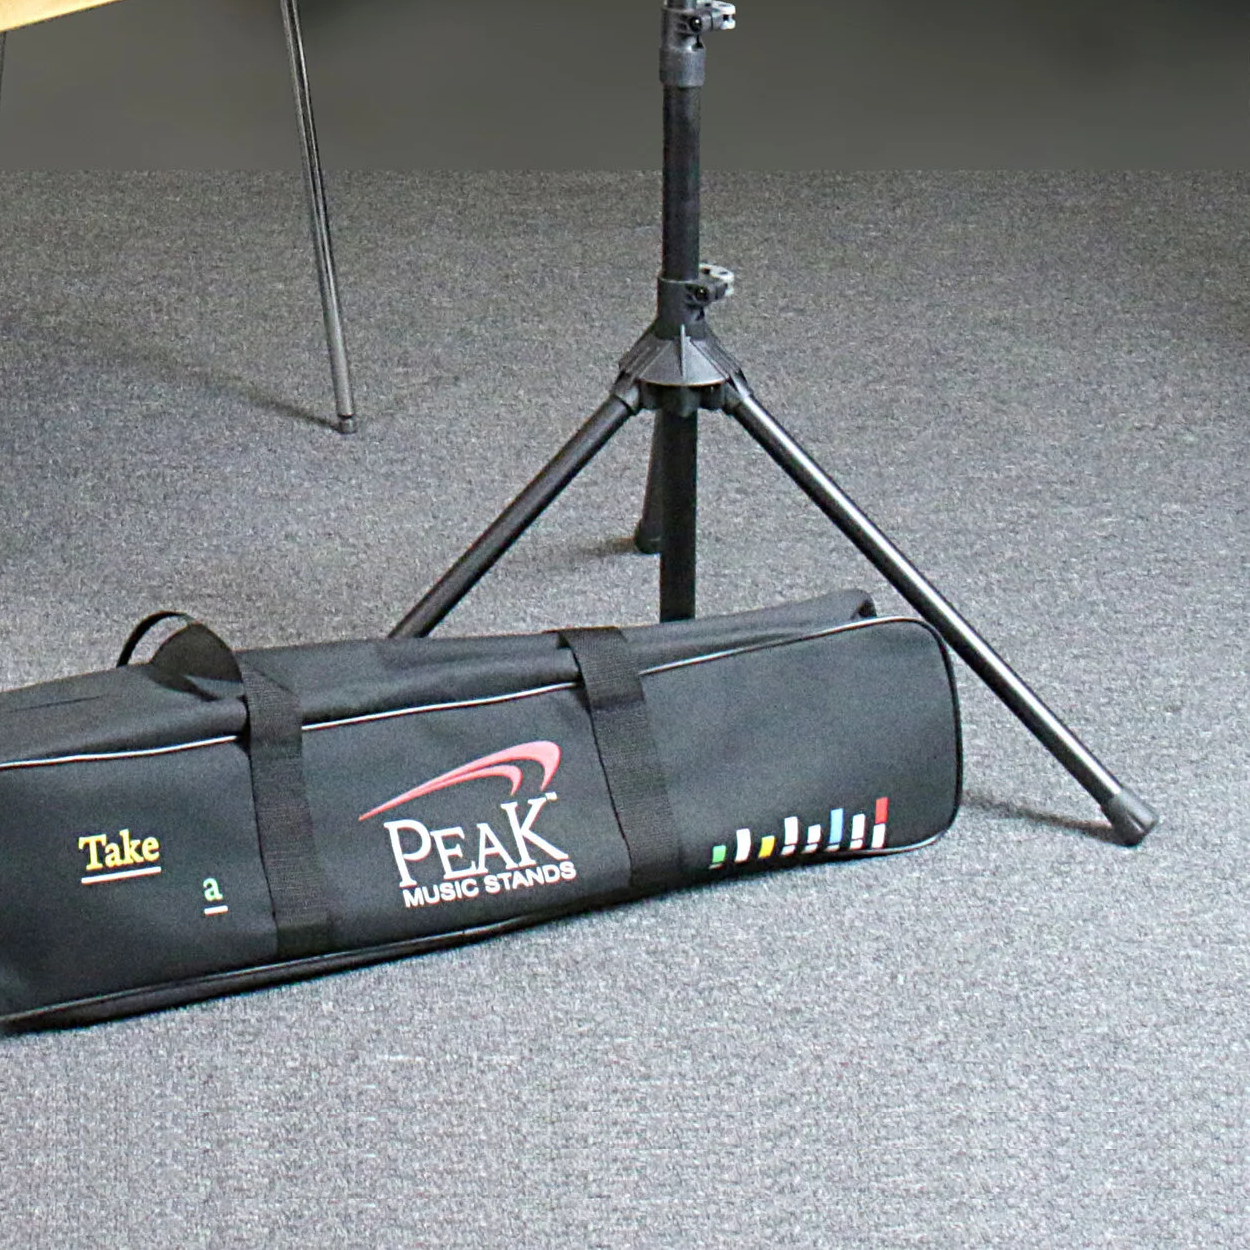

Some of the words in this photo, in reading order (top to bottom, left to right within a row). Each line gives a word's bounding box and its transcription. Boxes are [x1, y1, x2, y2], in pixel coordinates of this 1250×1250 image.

[78, 828, 160, 871] Take
[383, 796, 569, 887] PEAK
[203, 877, 223, 902] a
[402, 878, 480, 908] MUSIC
[484, 860, 578, 895] STANDS
